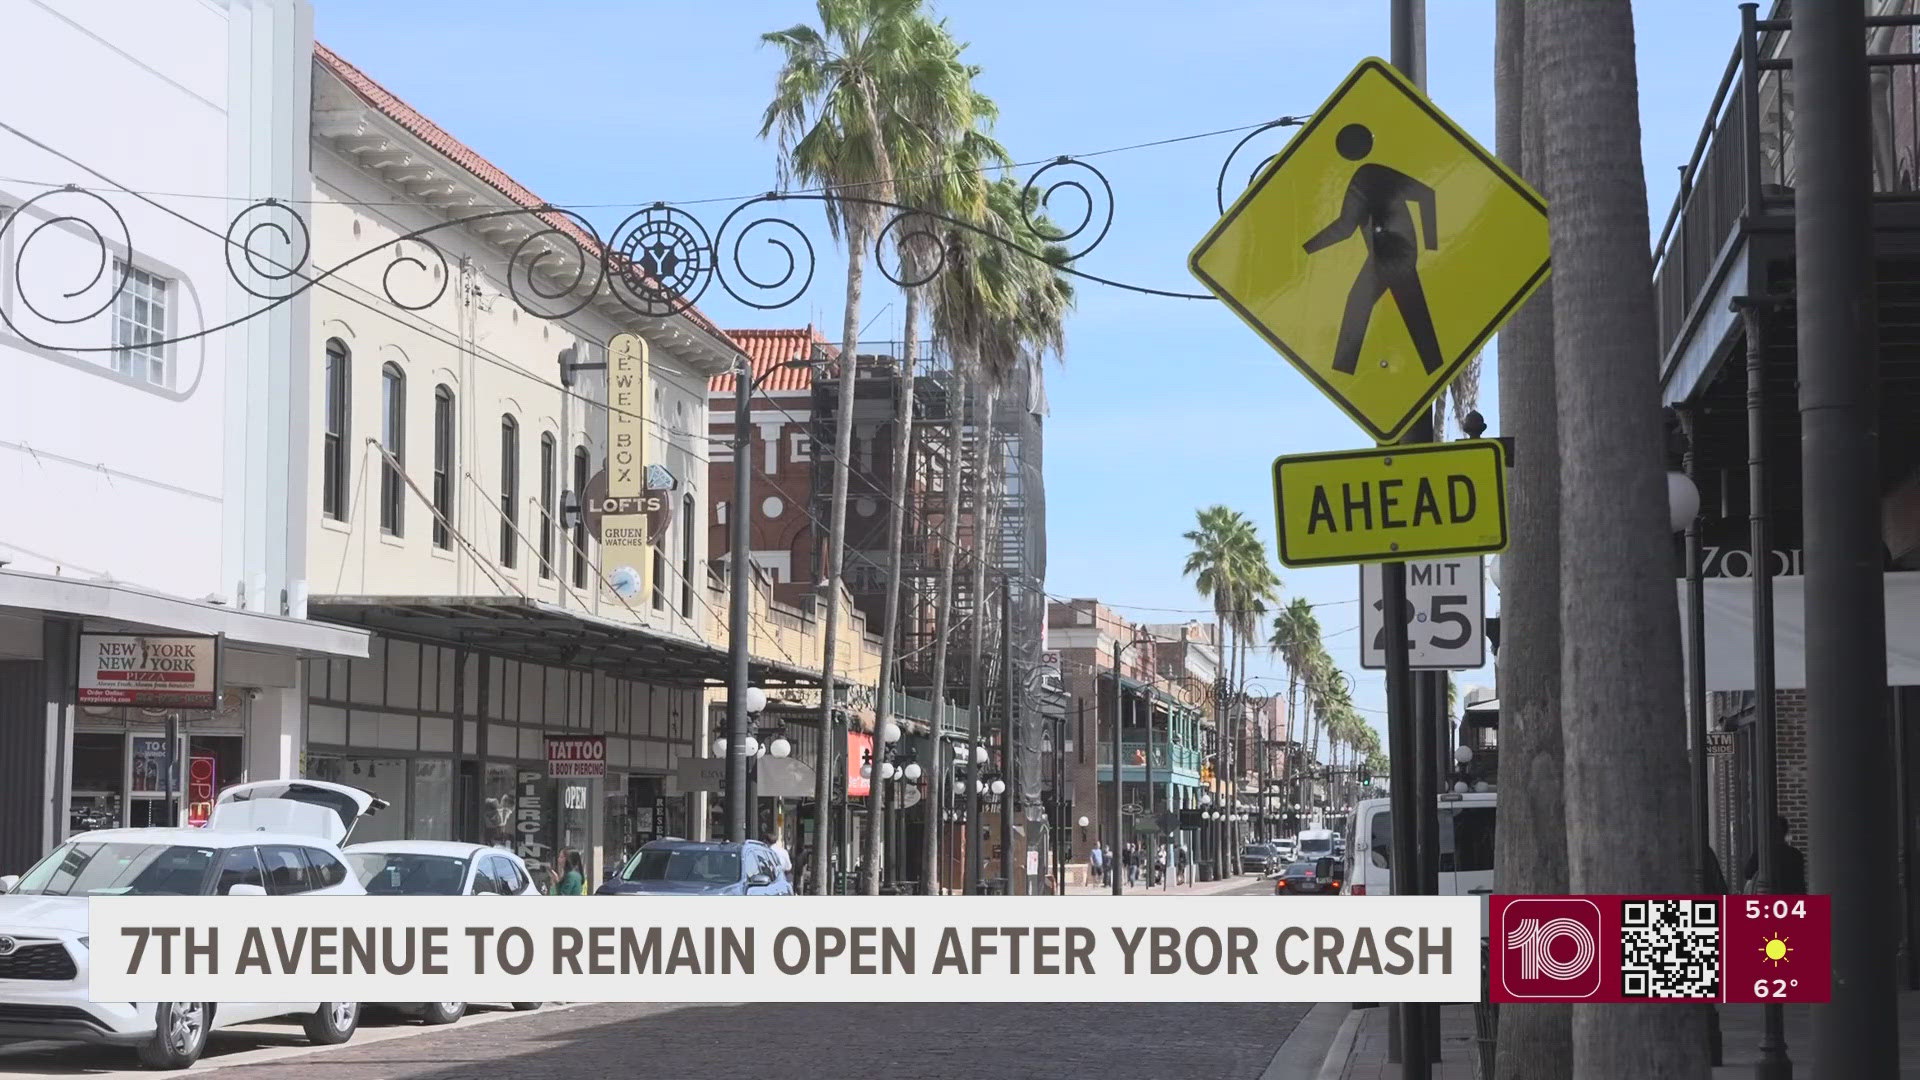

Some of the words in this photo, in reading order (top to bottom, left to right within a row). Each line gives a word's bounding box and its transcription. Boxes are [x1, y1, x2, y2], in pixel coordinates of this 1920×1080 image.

[648, 249, 670, 275] Y
[616, 340, 632, 424] JEWEL
[616, 434, 632, 482] BOX
[589, 498, 661, 513] LOFTS
[1307, 474, 1477, 535] AHEAD
[605, 529, 642, 538] GRUEN
[1411, 563, 1461, 586] MIT
[99, 643, 136, 656] NEW
[151, 645, 196, 658] YORK
[99, 657, 136, 670] NEW
[150, 659, 195, 671] YORK
[127, 672, 165, 681] PIZZA
[145, 741, 159, 751] TO
[551, 741, 603, 759] TATTOO
[1706, 745, 1732, 753] NSIDE
[556, 763, 572, 775] BODY
[574, 763, 604, 775] PIERCING
[565, 786, 587, 809] OPEN
[518, 772, 542, 870] PIERCING
